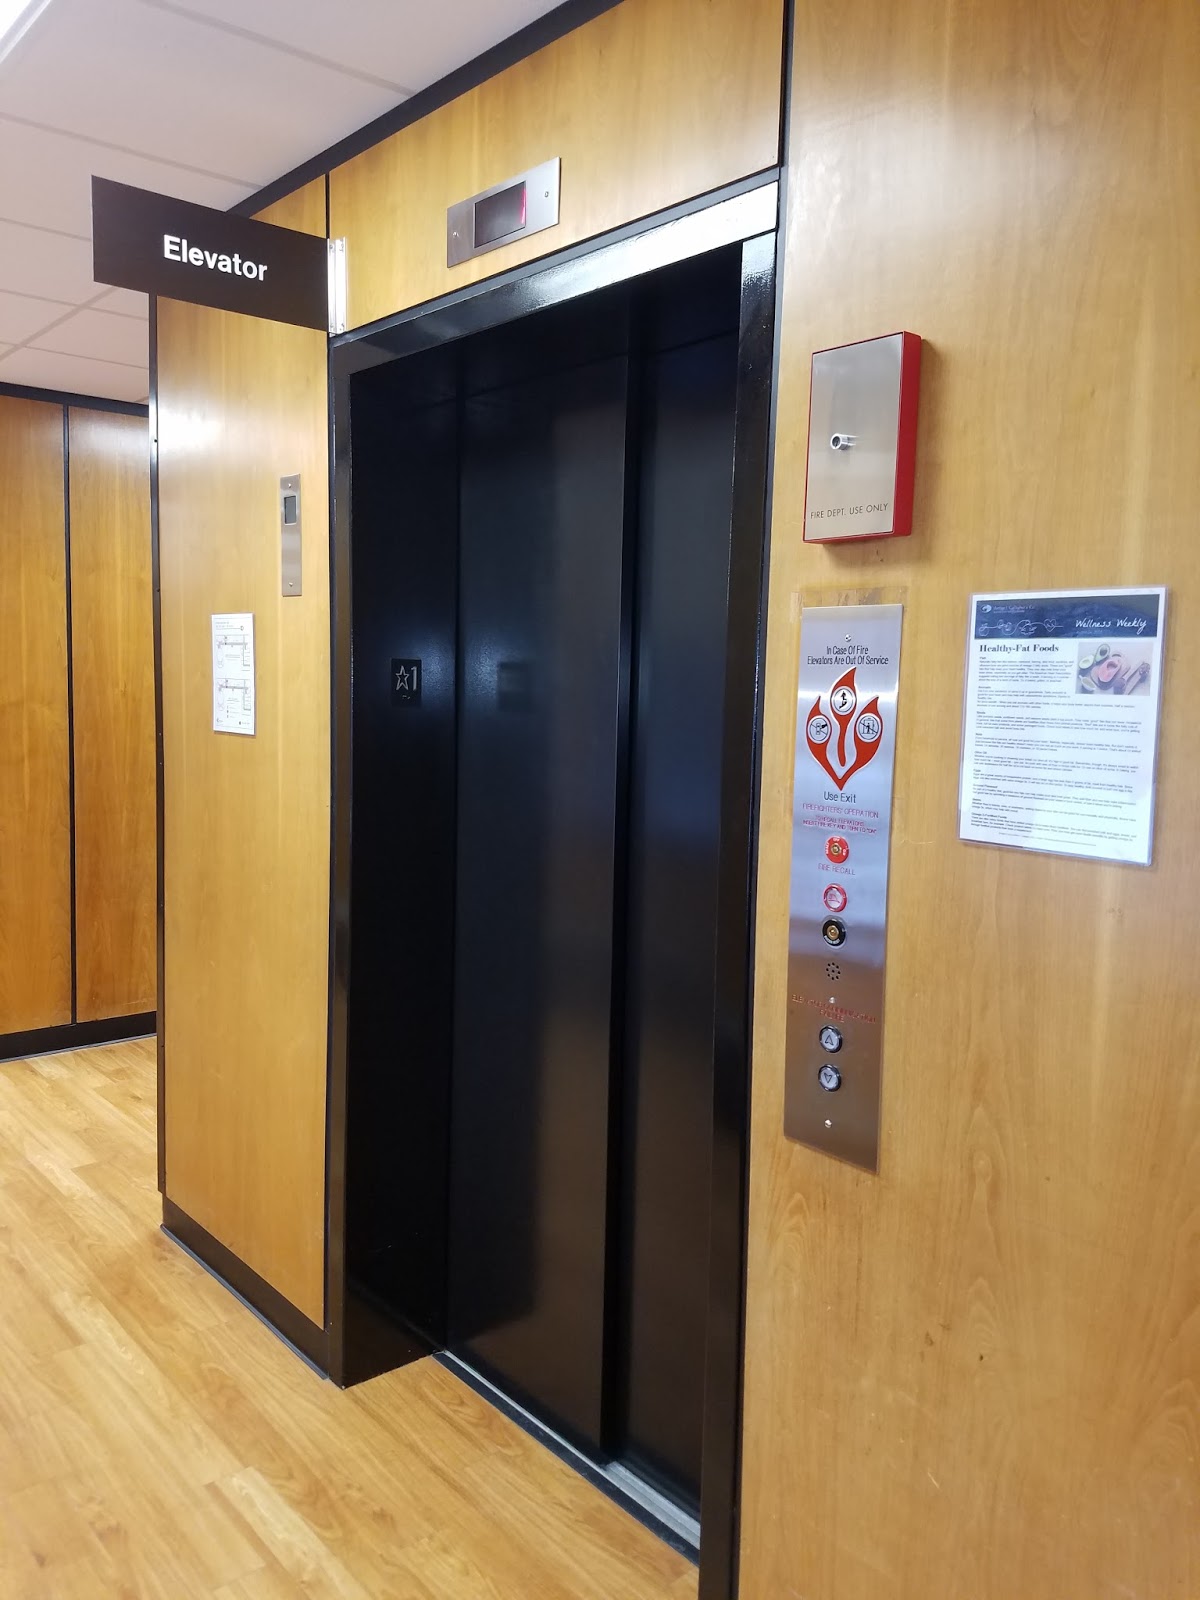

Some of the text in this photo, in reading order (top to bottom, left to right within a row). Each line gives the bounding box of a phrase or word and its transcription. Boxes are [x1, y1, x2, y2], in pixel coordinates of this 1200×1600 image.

[163, 234, 268, 281] Elevator
[810, 503, 889, 519] FIRE DEPT. USE ONLY
[1075, 618, 1112, 628] Wellness
[1116, 617, 1147, 635] Weekly
[826, 645, 869, 655] In Case Of Fire
[979, 644, 1059, 654] Healthy-Fat Foods
[807, 655, 889, 665] Elevators Are Out Of Service
[411, 666, 418, 691] 1
[824, 791, 856, 803] Use Exit
[844, 808, 879, 818] OPERATION
[831, 864, 855, 876] RECALL
